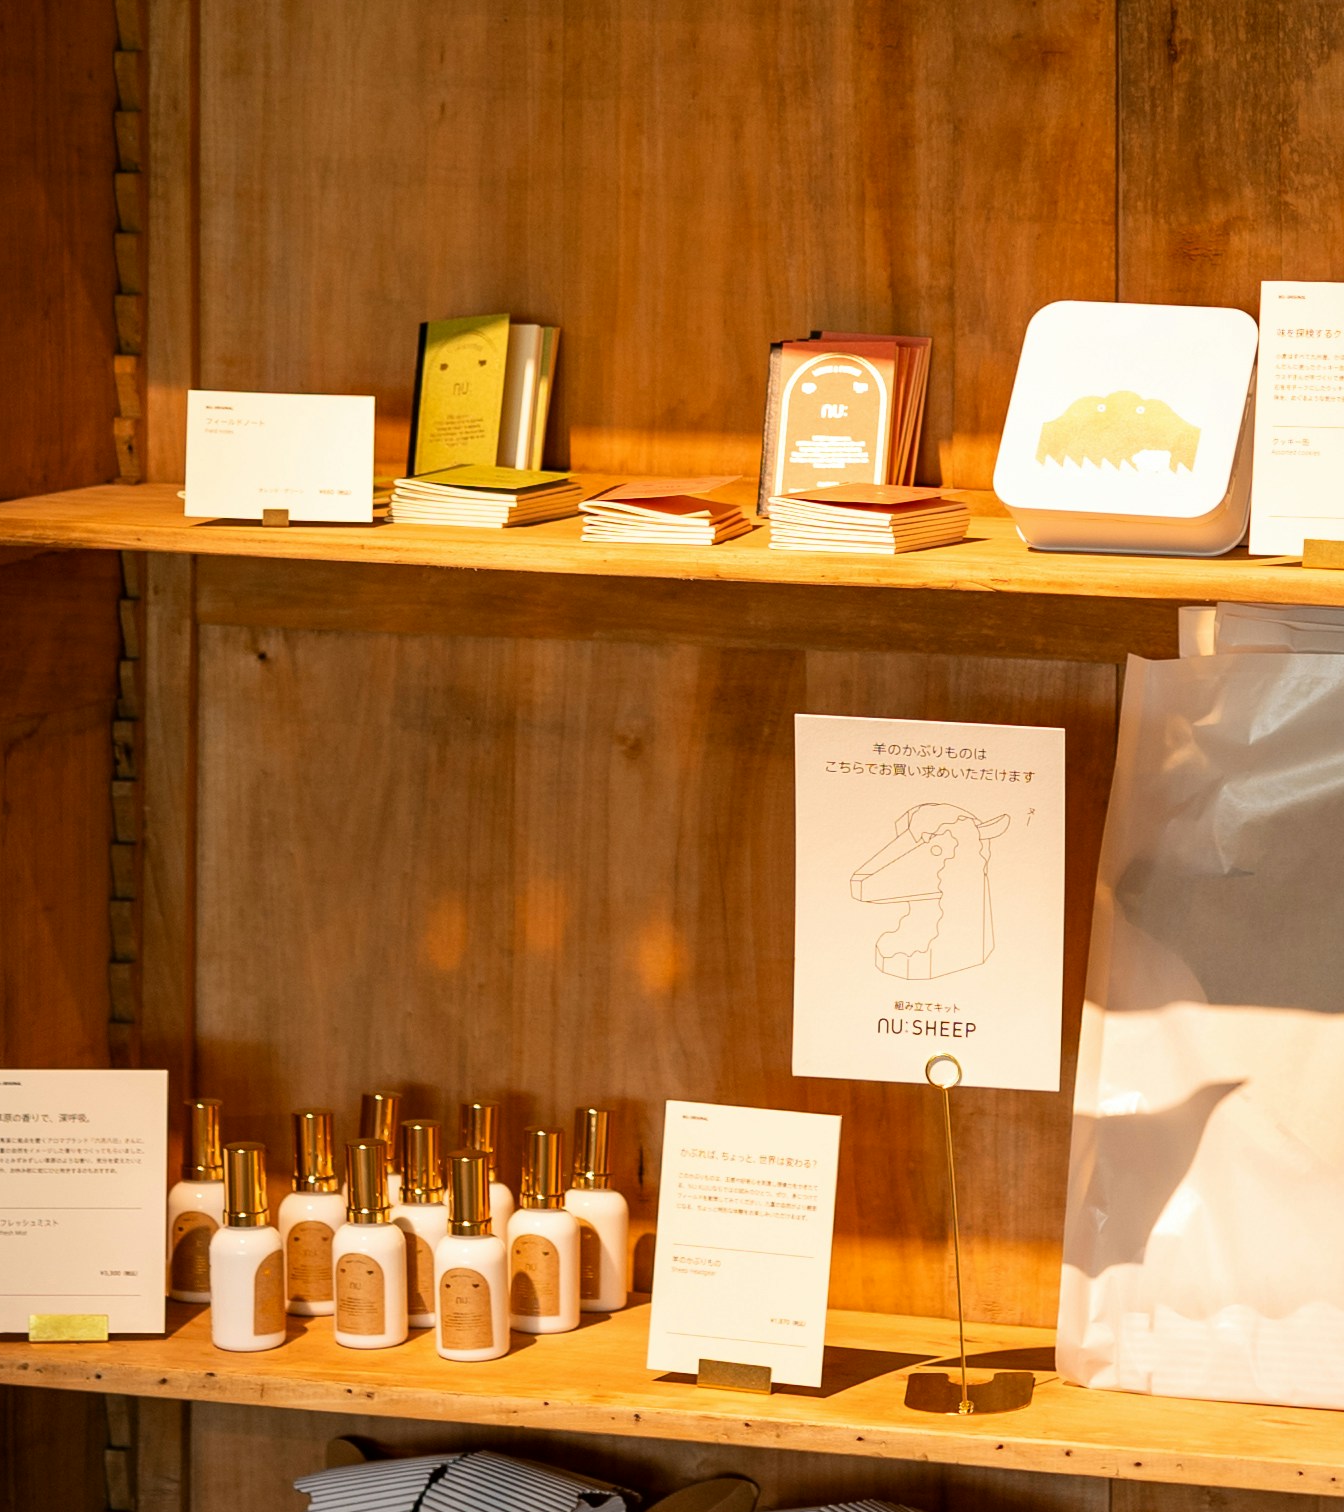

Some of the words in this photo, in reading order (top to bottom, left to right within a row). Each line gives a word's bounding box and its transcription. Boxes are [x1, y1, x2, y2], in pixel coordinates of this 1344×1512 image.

[872, 741, 988, 761] 羊のかぶりものは
[824, 760, 1036, 784] こちらでお買い求めいただけます
[894, 1000, 961, 1014] 組み立てキット
